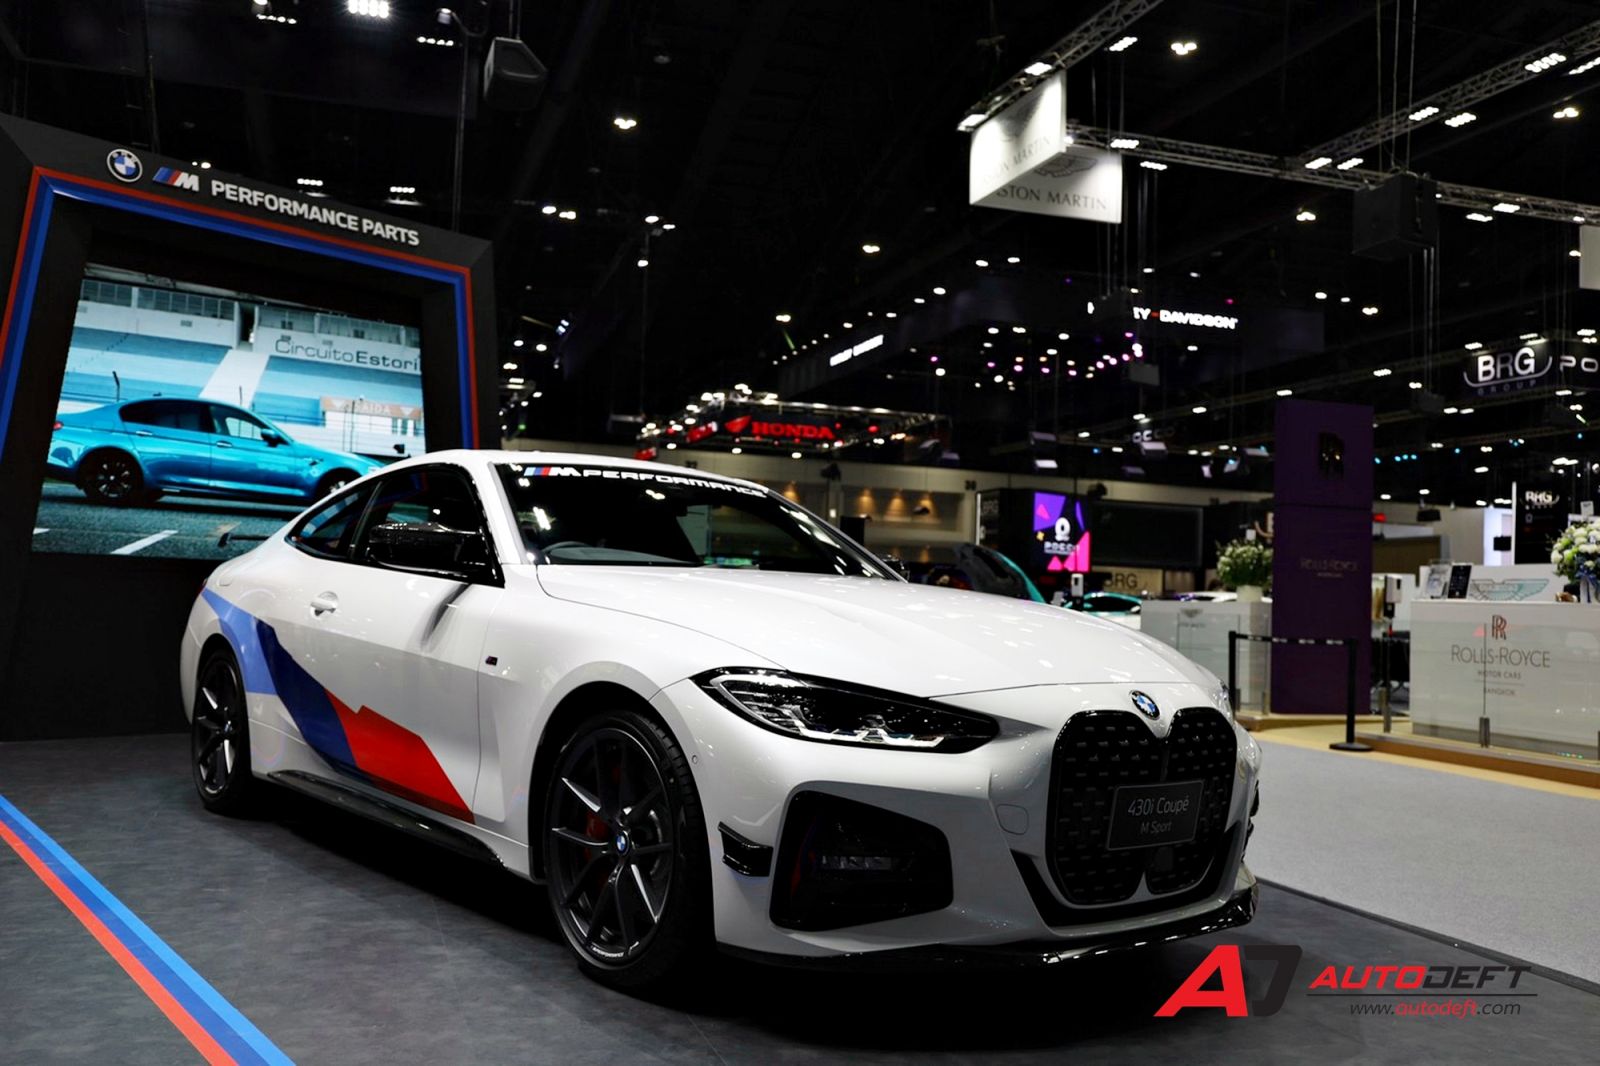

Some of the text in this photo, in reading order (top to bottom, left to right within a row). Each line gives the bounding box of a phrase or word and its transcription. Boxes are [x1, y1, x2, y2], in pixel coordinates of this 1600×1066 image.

[996, 184, 1107, 209] STON MARTIN
[210, 179, 360, 232] PERFORMANCE
[361, 218, 420, 246] PARTS
[1478, 347, 1535, 382] BRG
[751, 420, 835, 440] HONDA
[583, 469, 767, 498] PERFORMANCE
[1451, 644, 1551, 668] ROLLS-ROYCE
[1127, 798, 1155, 817] 430i
[1140, 821, 1150, 835] M
